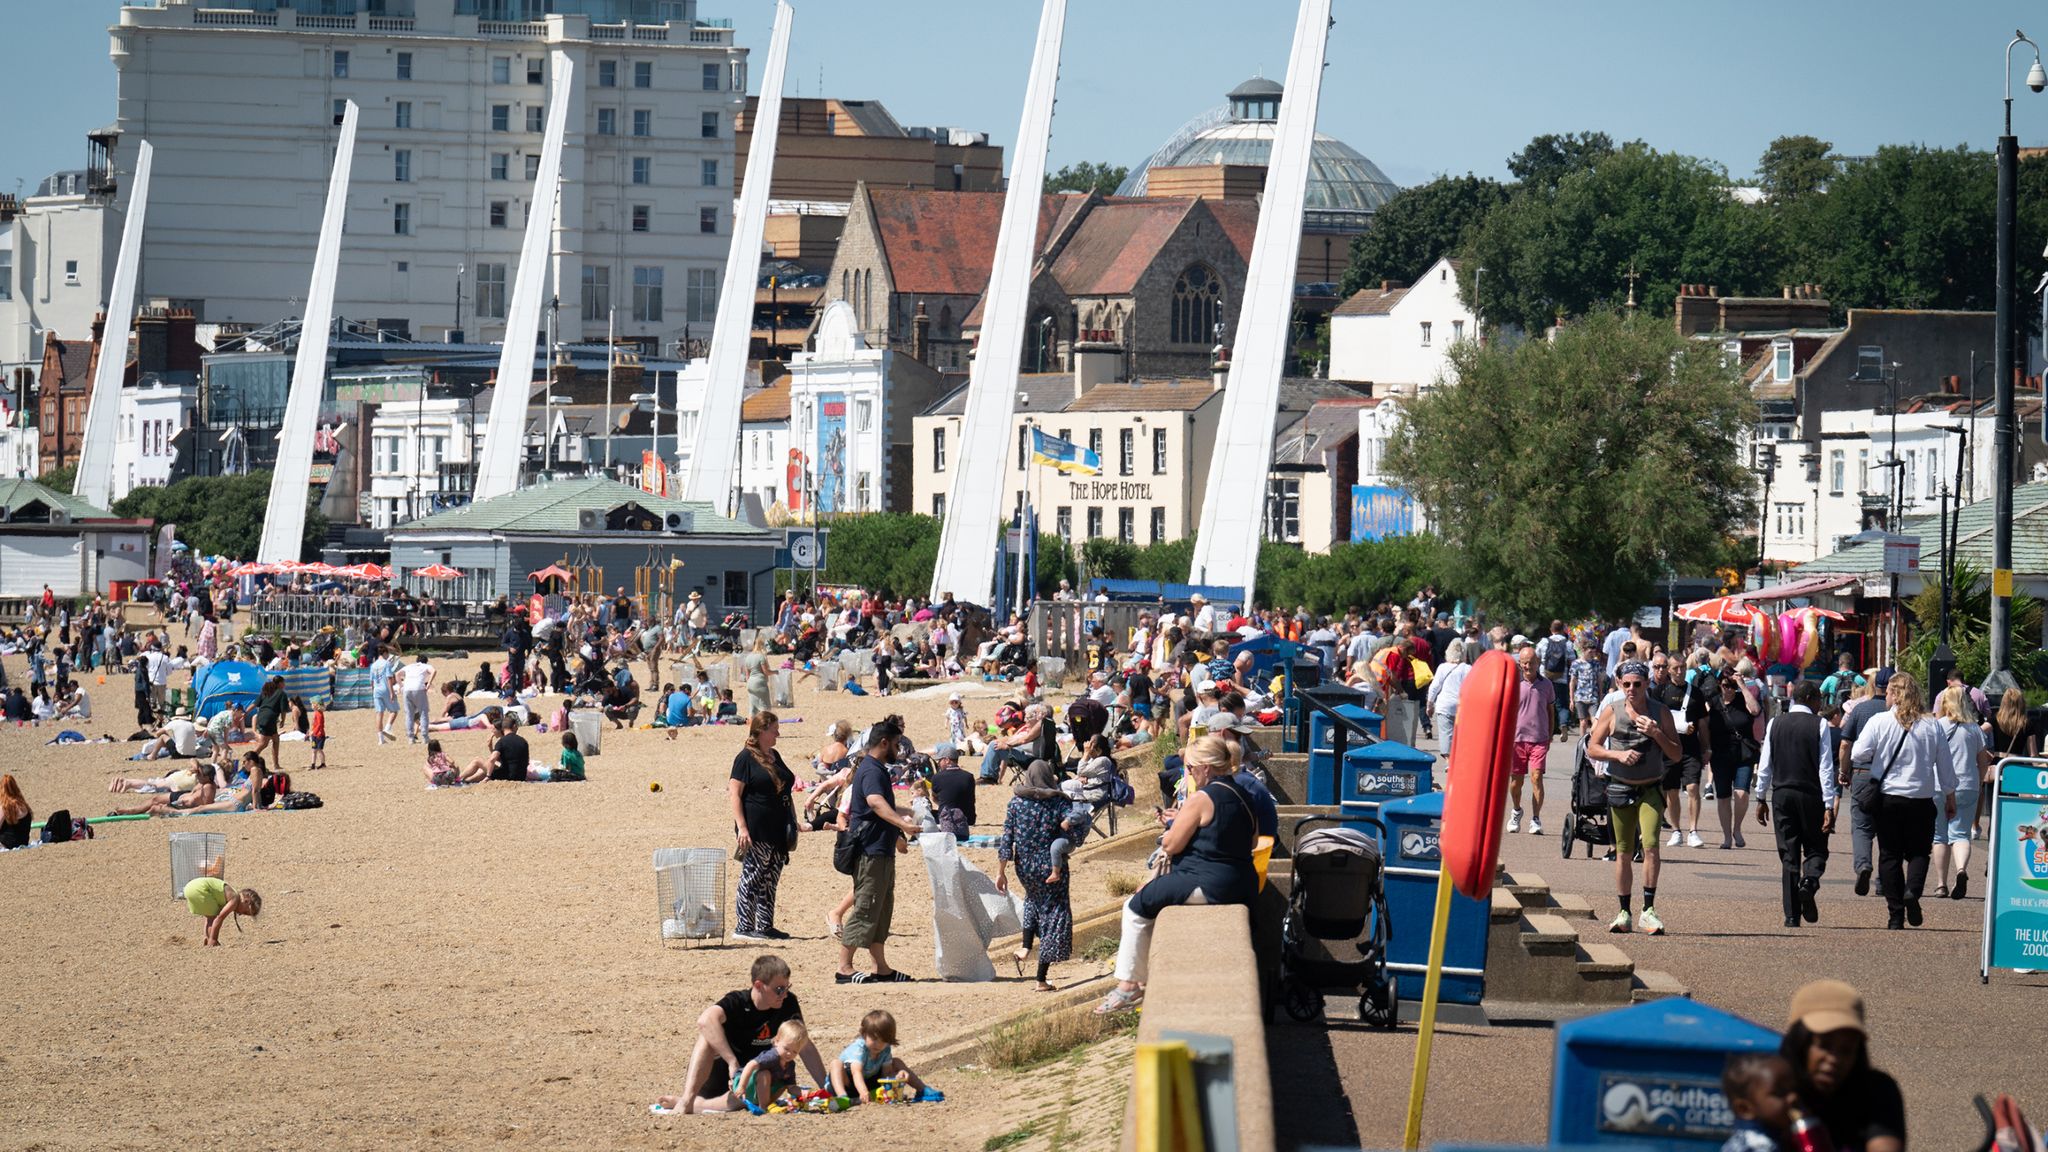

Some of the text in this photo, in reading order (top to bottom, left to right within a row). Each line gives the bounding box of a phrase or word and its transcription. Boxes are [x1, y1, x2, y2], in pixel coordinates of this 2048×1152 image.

[1069, 481, 1152, 500] THE HOPE HOTEL
[2015, 928, 2031, 941] THE
